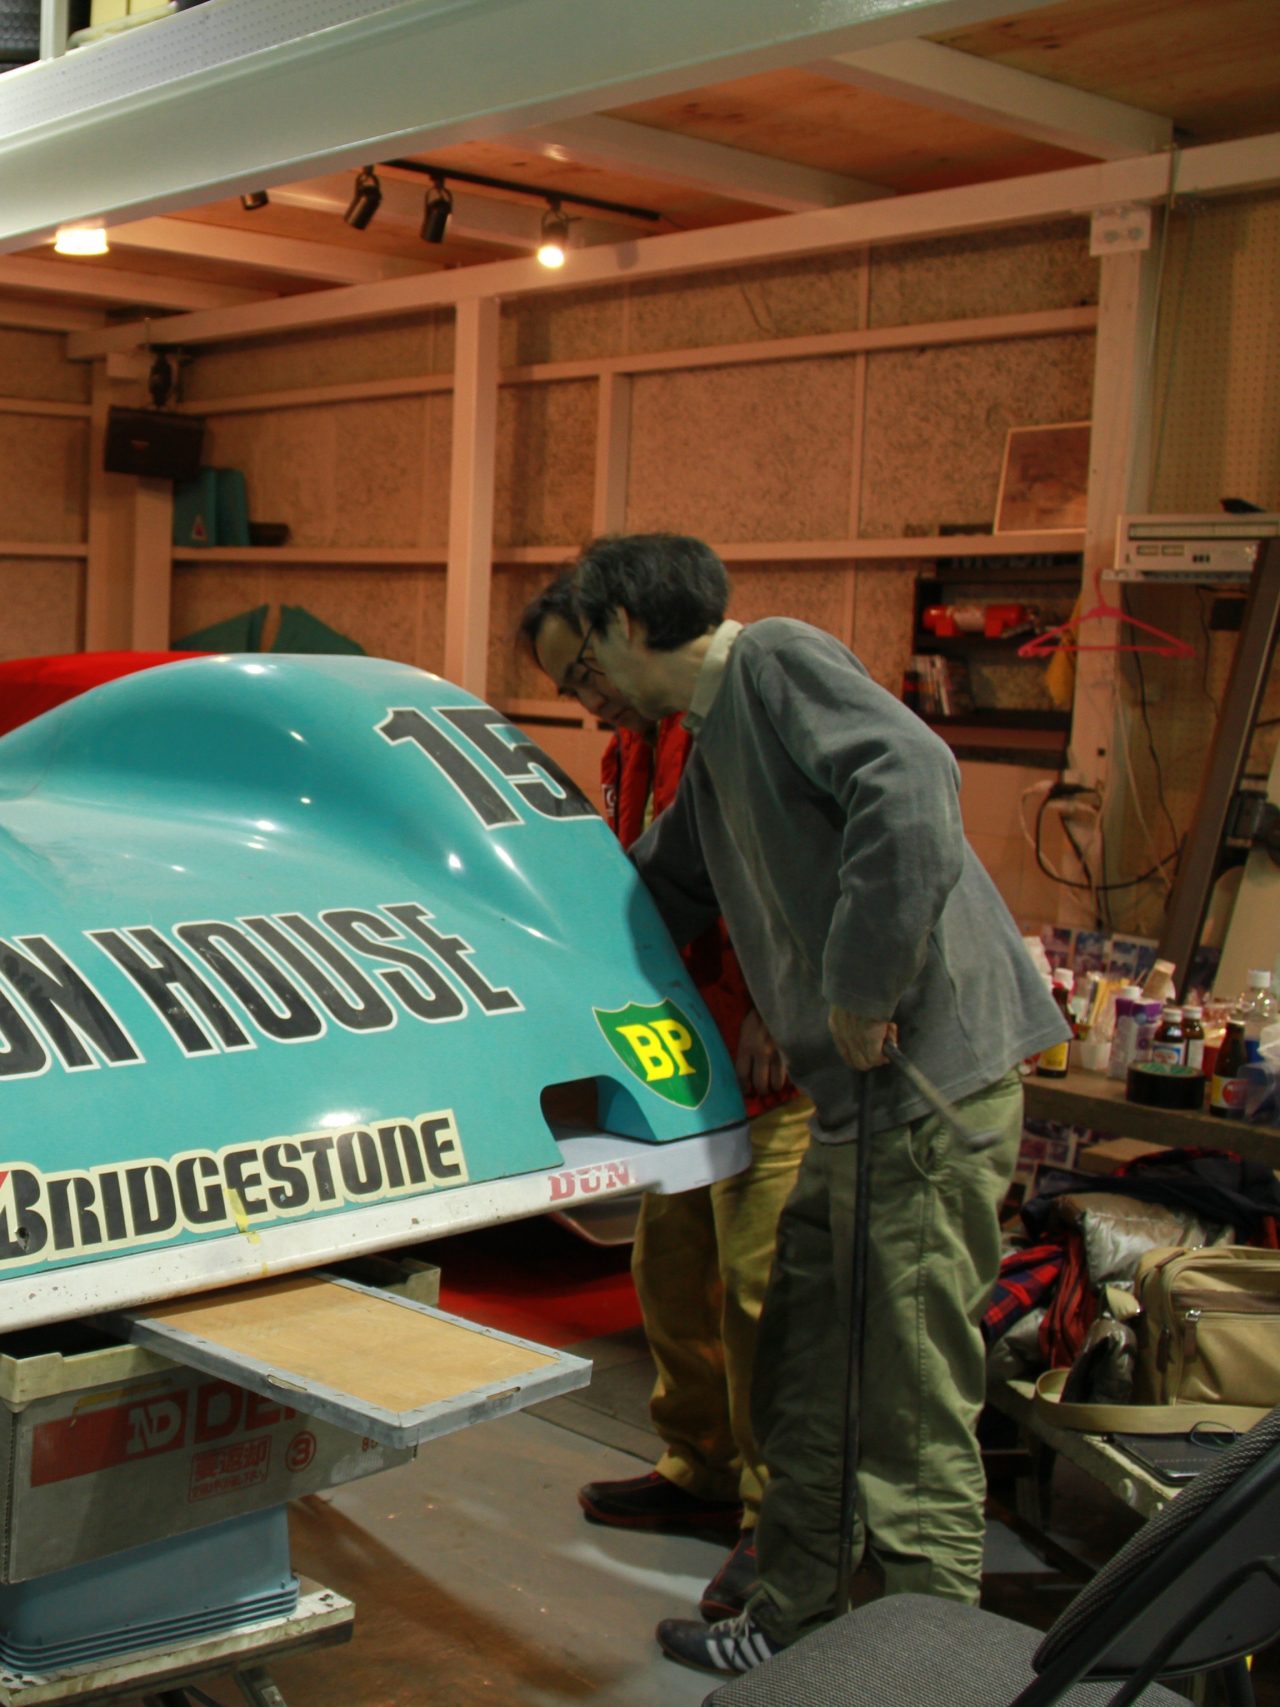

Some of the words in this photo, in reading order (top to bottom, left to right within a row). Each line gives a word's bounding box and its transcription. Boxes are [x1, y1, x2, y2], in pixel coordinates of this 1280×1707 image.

[373, 706, 604, 831] 15
[83, 902, 526, 1058] HOUSE
[615, 1018, 697, 1082] BP
